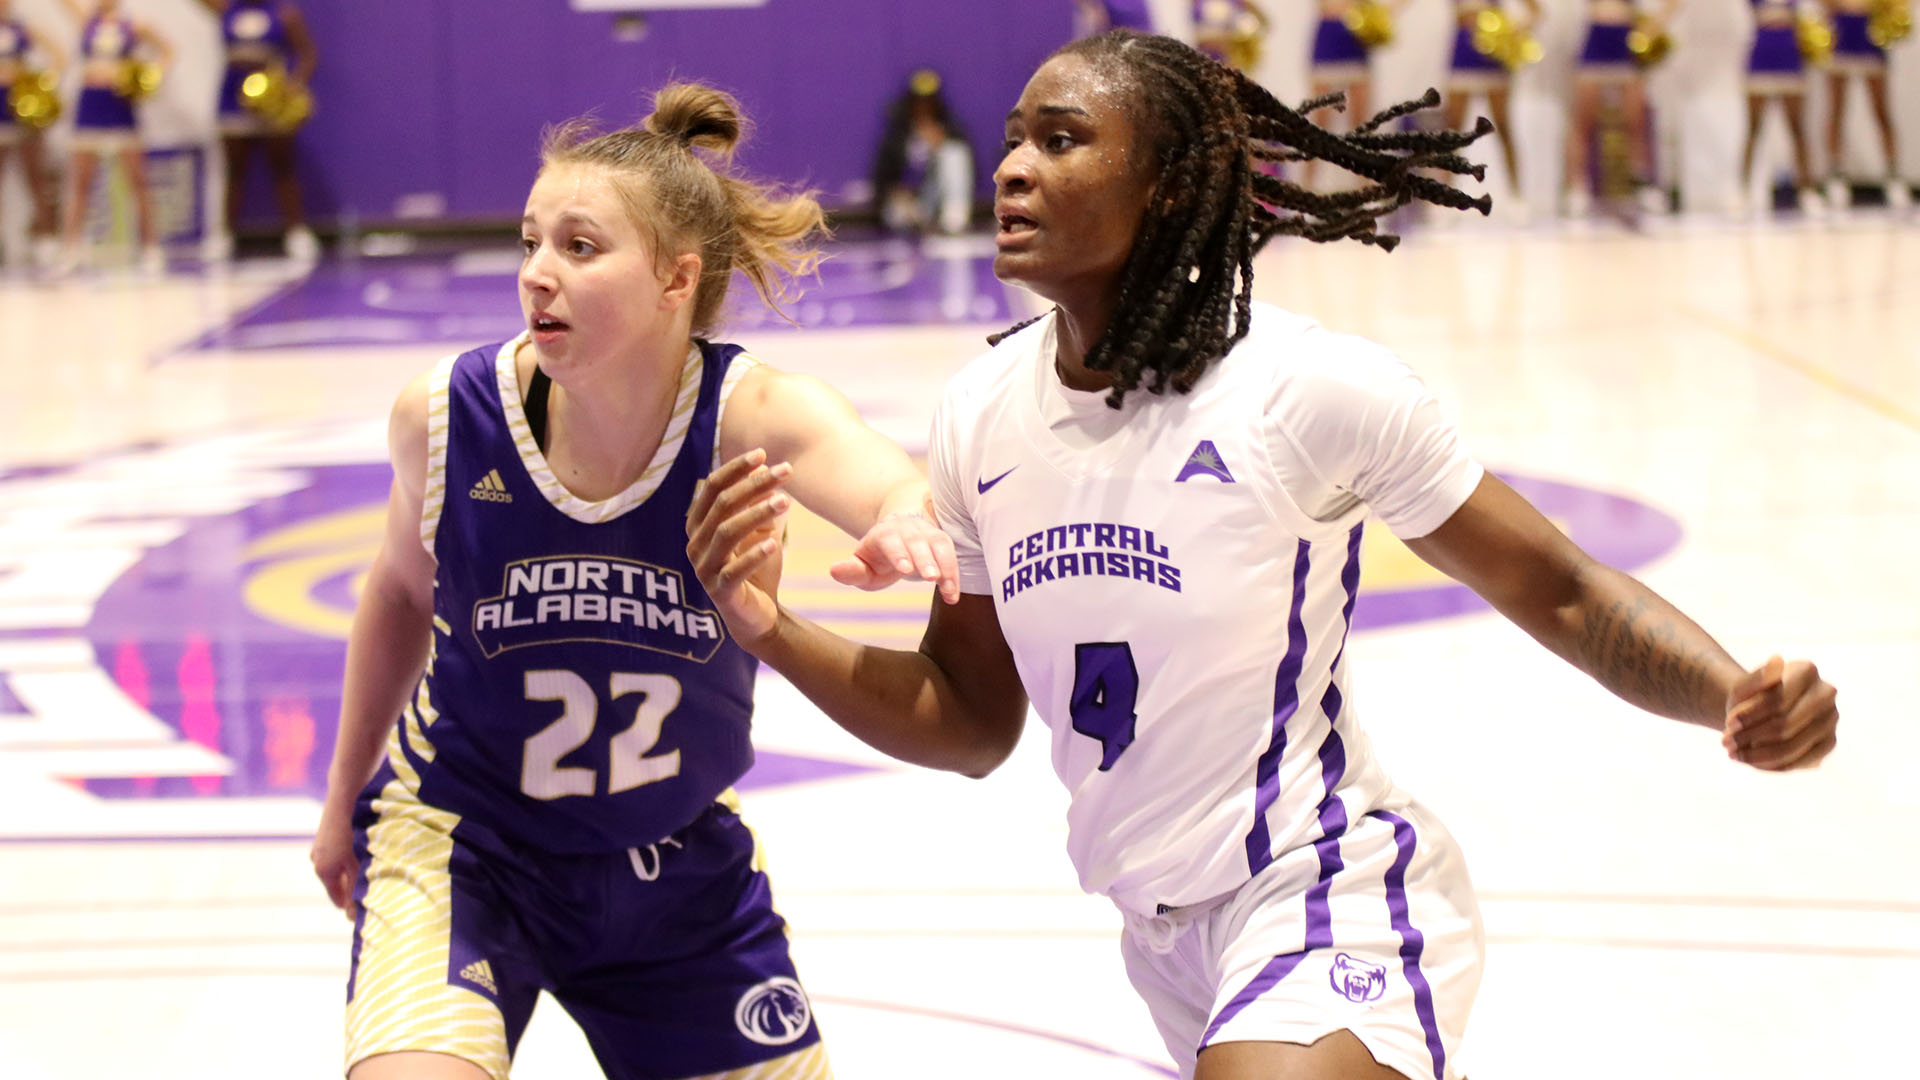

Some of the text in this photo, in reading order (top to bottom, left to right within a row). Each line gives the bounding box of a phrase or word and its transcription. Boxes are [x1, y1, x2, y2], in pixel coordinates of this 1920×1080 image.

[469, 489, 513, 503] adidas
[1008, 522, 1169, 570] CENTRAL
[508, 560, 680, 604] NORTH
[1002, 552, 1182, 603] ARKANSAS
[476, 594, 718, 640] ALABAMA
[1069, 641, 1140, 772] 4
[520, 669, 683, 800] 22
[460, 969, 498, 996] adidas
